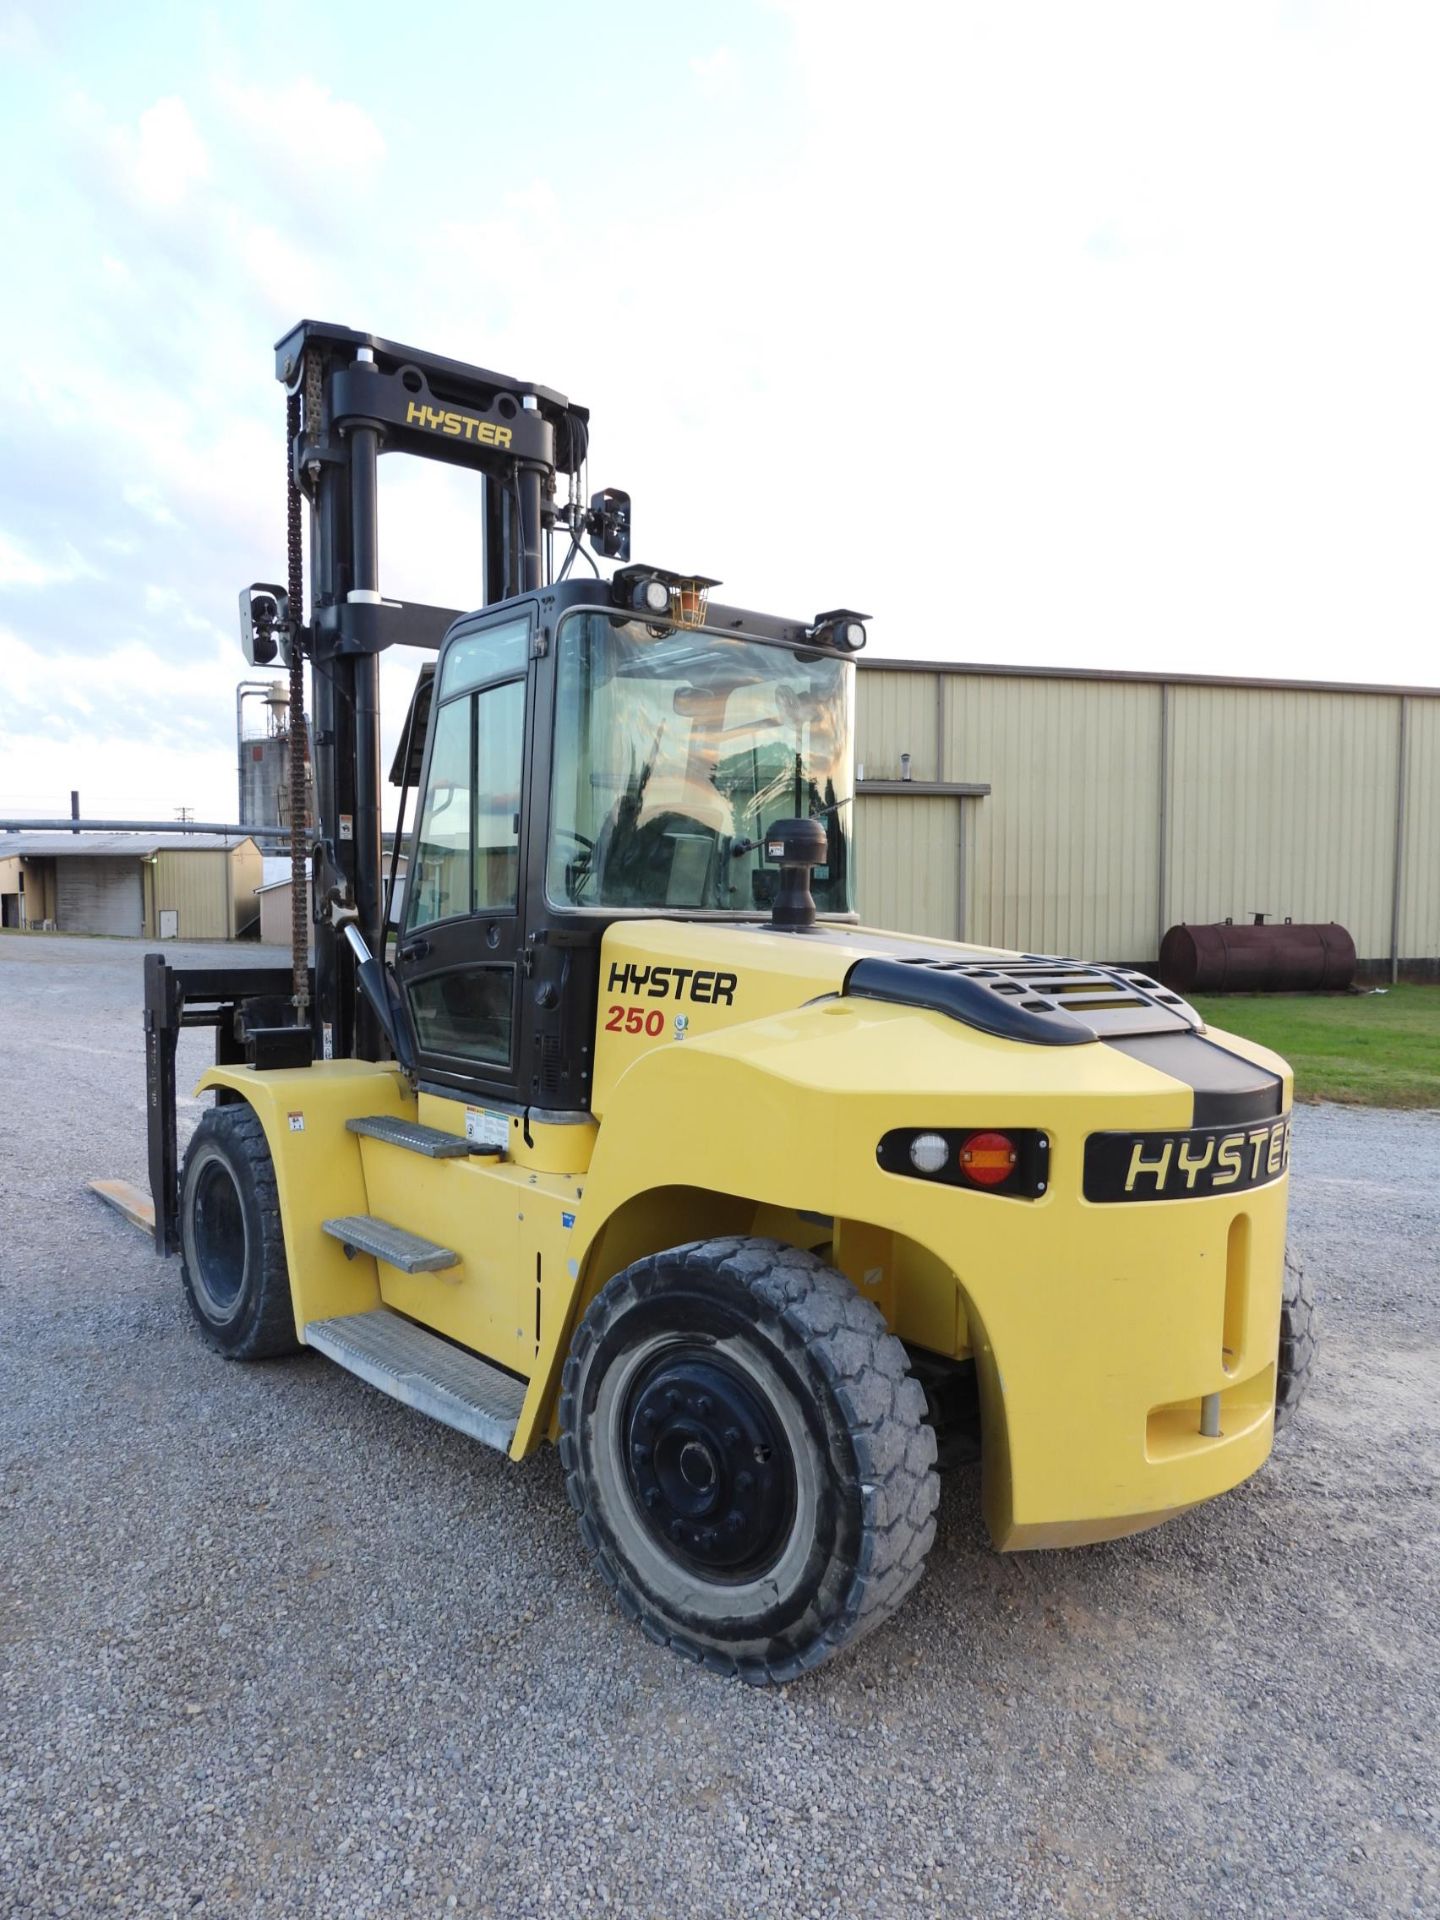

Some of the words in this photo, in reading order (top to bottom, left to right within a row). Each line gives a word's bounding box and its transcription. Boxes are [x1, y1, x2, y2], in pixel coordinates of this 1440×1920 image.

[406, 401, 512, 449] HYSTER
[607, 962, 738, 1006] HYSTER
[605, 1005, 665, 1037] 250
